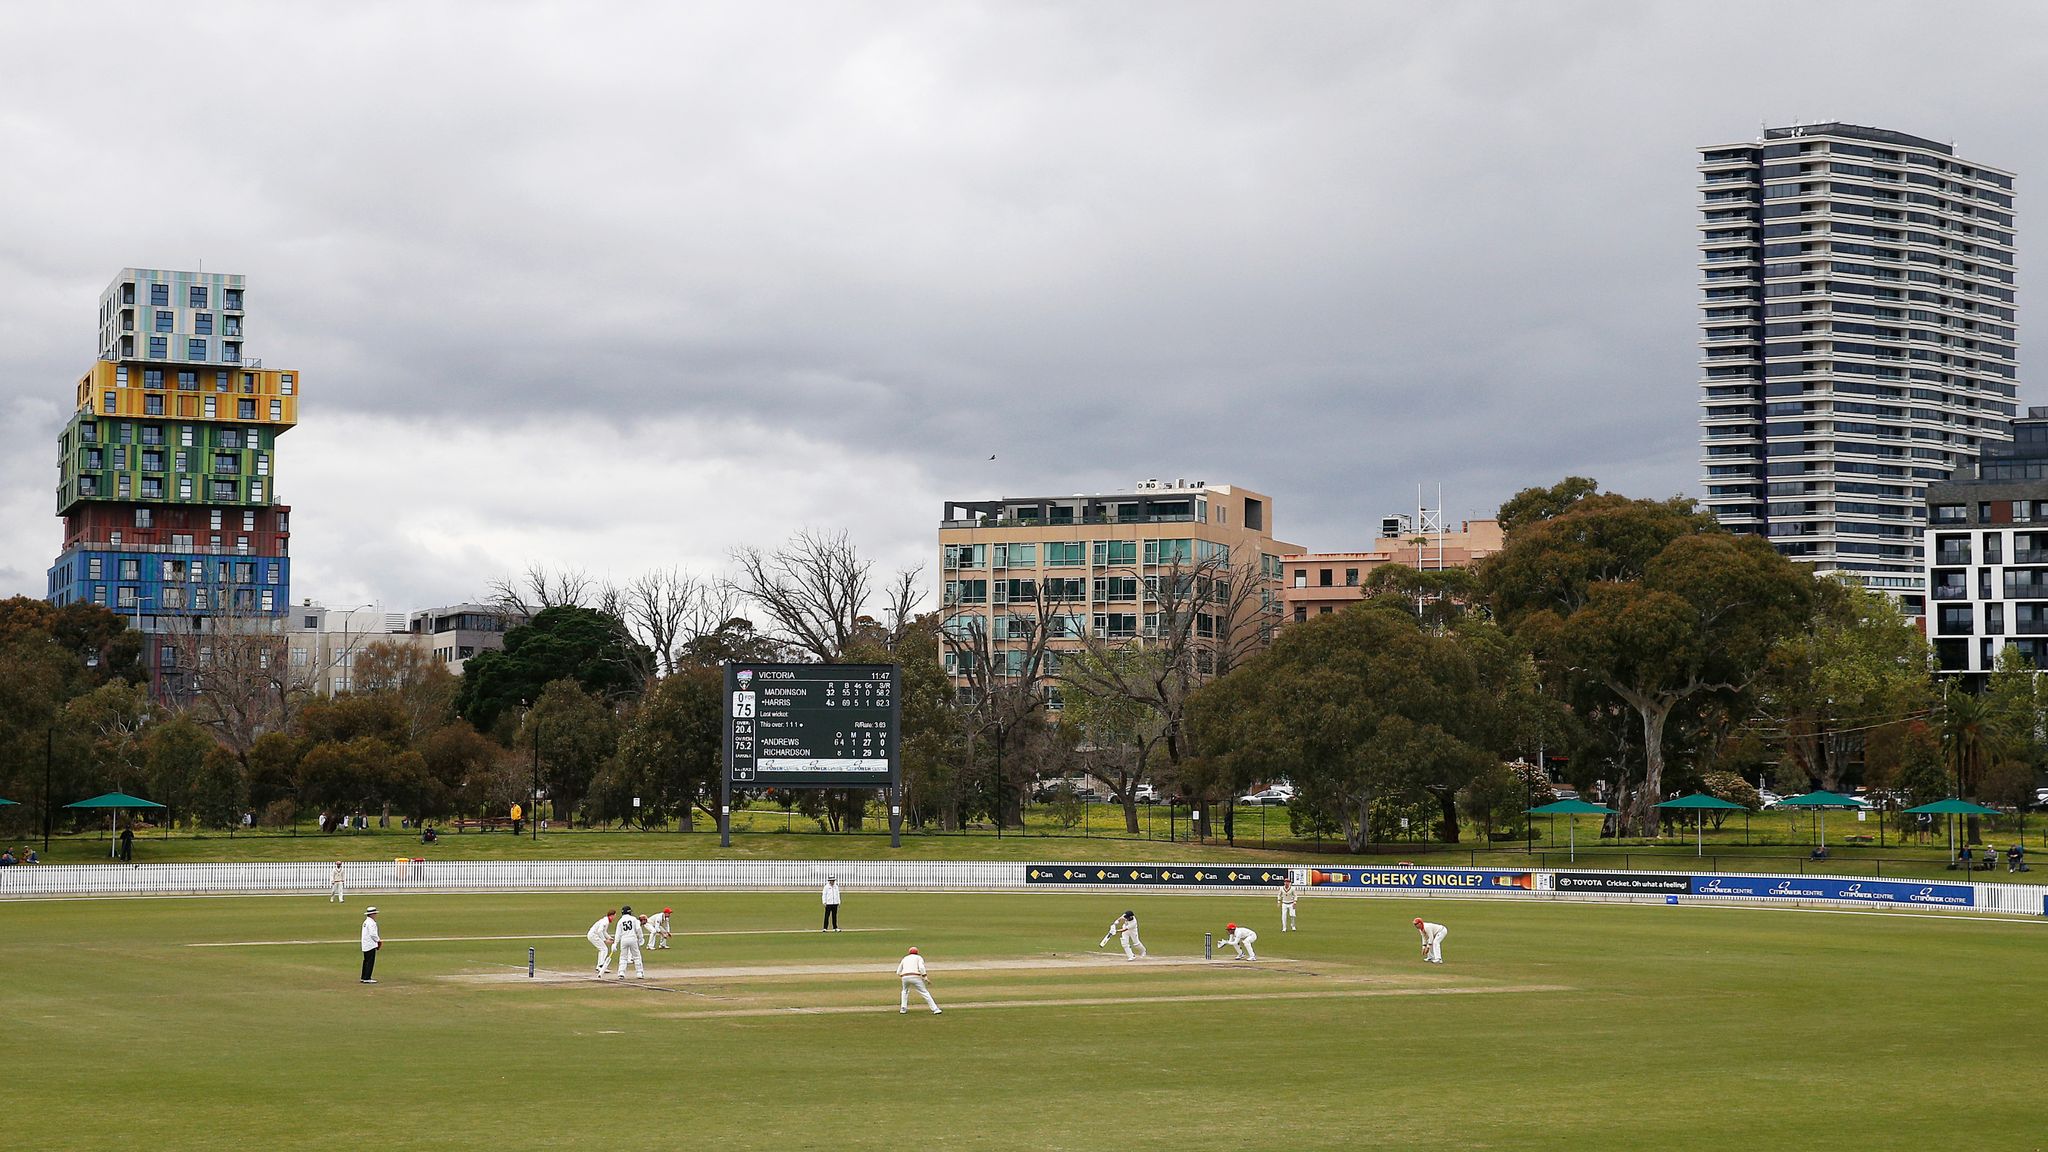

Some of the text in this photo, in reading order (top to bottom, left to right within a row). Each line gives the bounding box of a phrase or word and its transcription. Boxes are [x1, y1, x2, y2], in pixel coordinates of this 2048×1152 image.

[758, 671, 795, 679] VICTORIA
[871, 672, 890, 680] 11:47
[764, 688, 807, 696] MADDINSON
[825, 688, 835, 697] 32
[842, 688, 851, 696] 55
[854, 688, 859, 696] 3
[865, 688, 871, 696] 0
[738, 693, 744, 702] 0
[842, 699, 851, 707] 69
[854, 699, 859, 707] 5
[865, 699, 870, 707] 1
[737, 703, 752, 717] 75
[735, 725, 752, 734] 20.4
[865, 731, 871, 739] R
[879, 731, 887, 739] W
[735, 741, 752, 750] 75.2
[851, 738, 856, 746] 1
[862, 738, 872, 747] 27
[880, 738, 885, 747] 0
[763, 748, 811, 757] RICHARDSON
[851, 749, 856, 757] 1
[880, 749, 885, 757] 0
[740, 771, 746, 779] 0
[1360, 873, 1483, 886] CHEEKY SINGLE?
[1663, 881, 1687, 890] feeling!
[1944, 896, 1967, 904] CENTRE
[622, 920, 633, 931] 53
